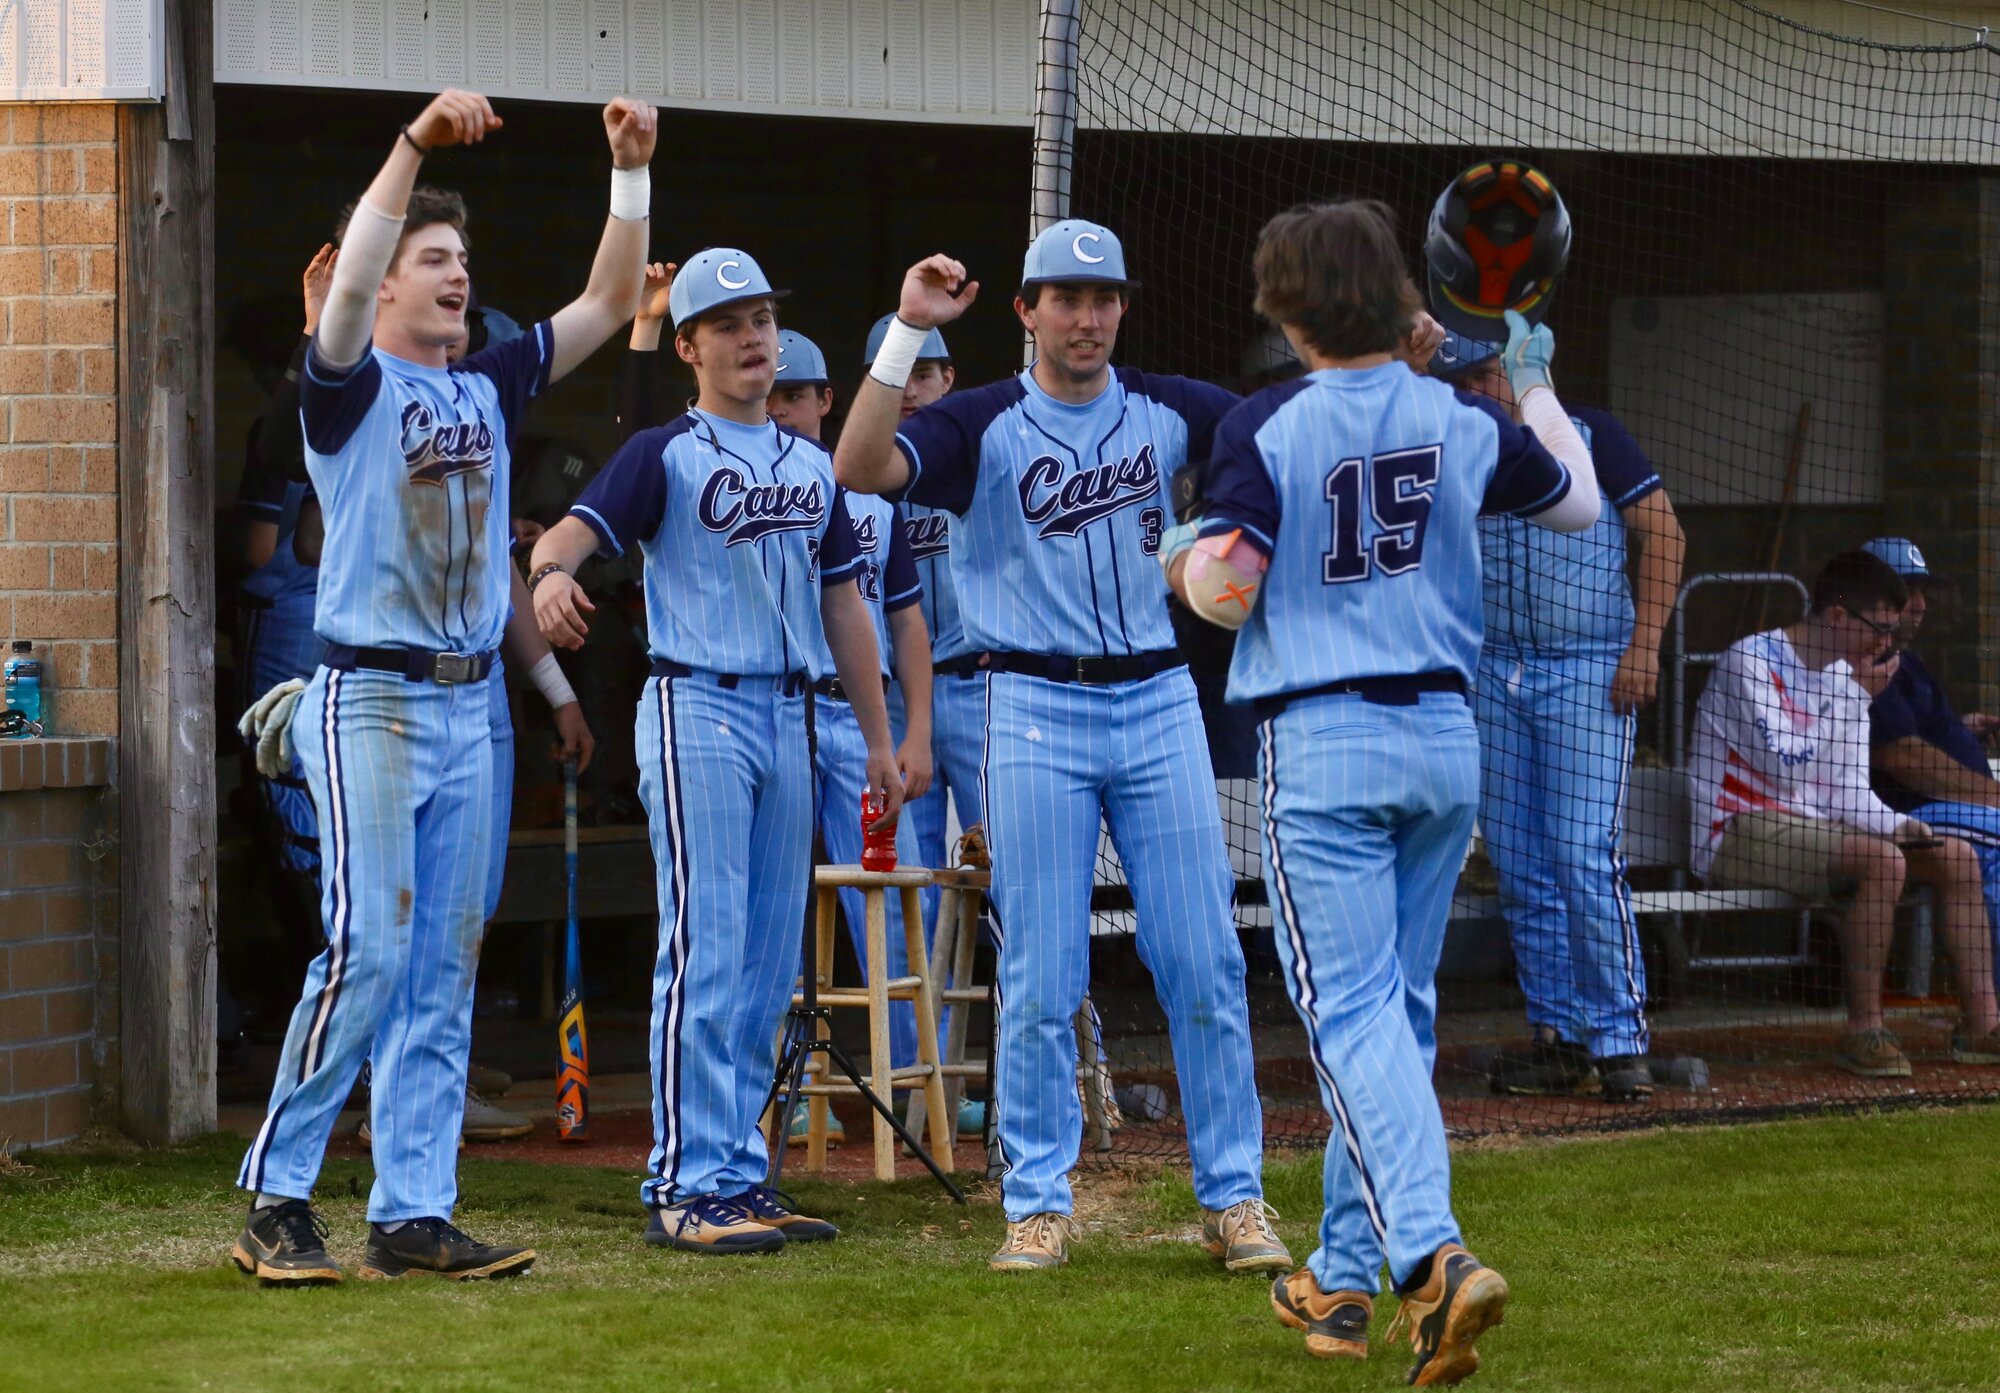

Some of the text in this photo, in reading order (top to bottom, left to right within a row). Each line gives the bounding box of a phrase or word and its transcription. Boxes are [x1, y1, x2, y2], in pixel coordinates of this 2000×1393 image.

[716, 260, 751, 290] C
[1071, 231, 1105, 264] C
[400, 400, 494, 465] Cavs
[698, 467, 824, 533] Cavs
[1018, 442, 1158, 524] Cavs
[1321, 443, 1443, 585] 15
[1139, 507, 1165, 556] 3
